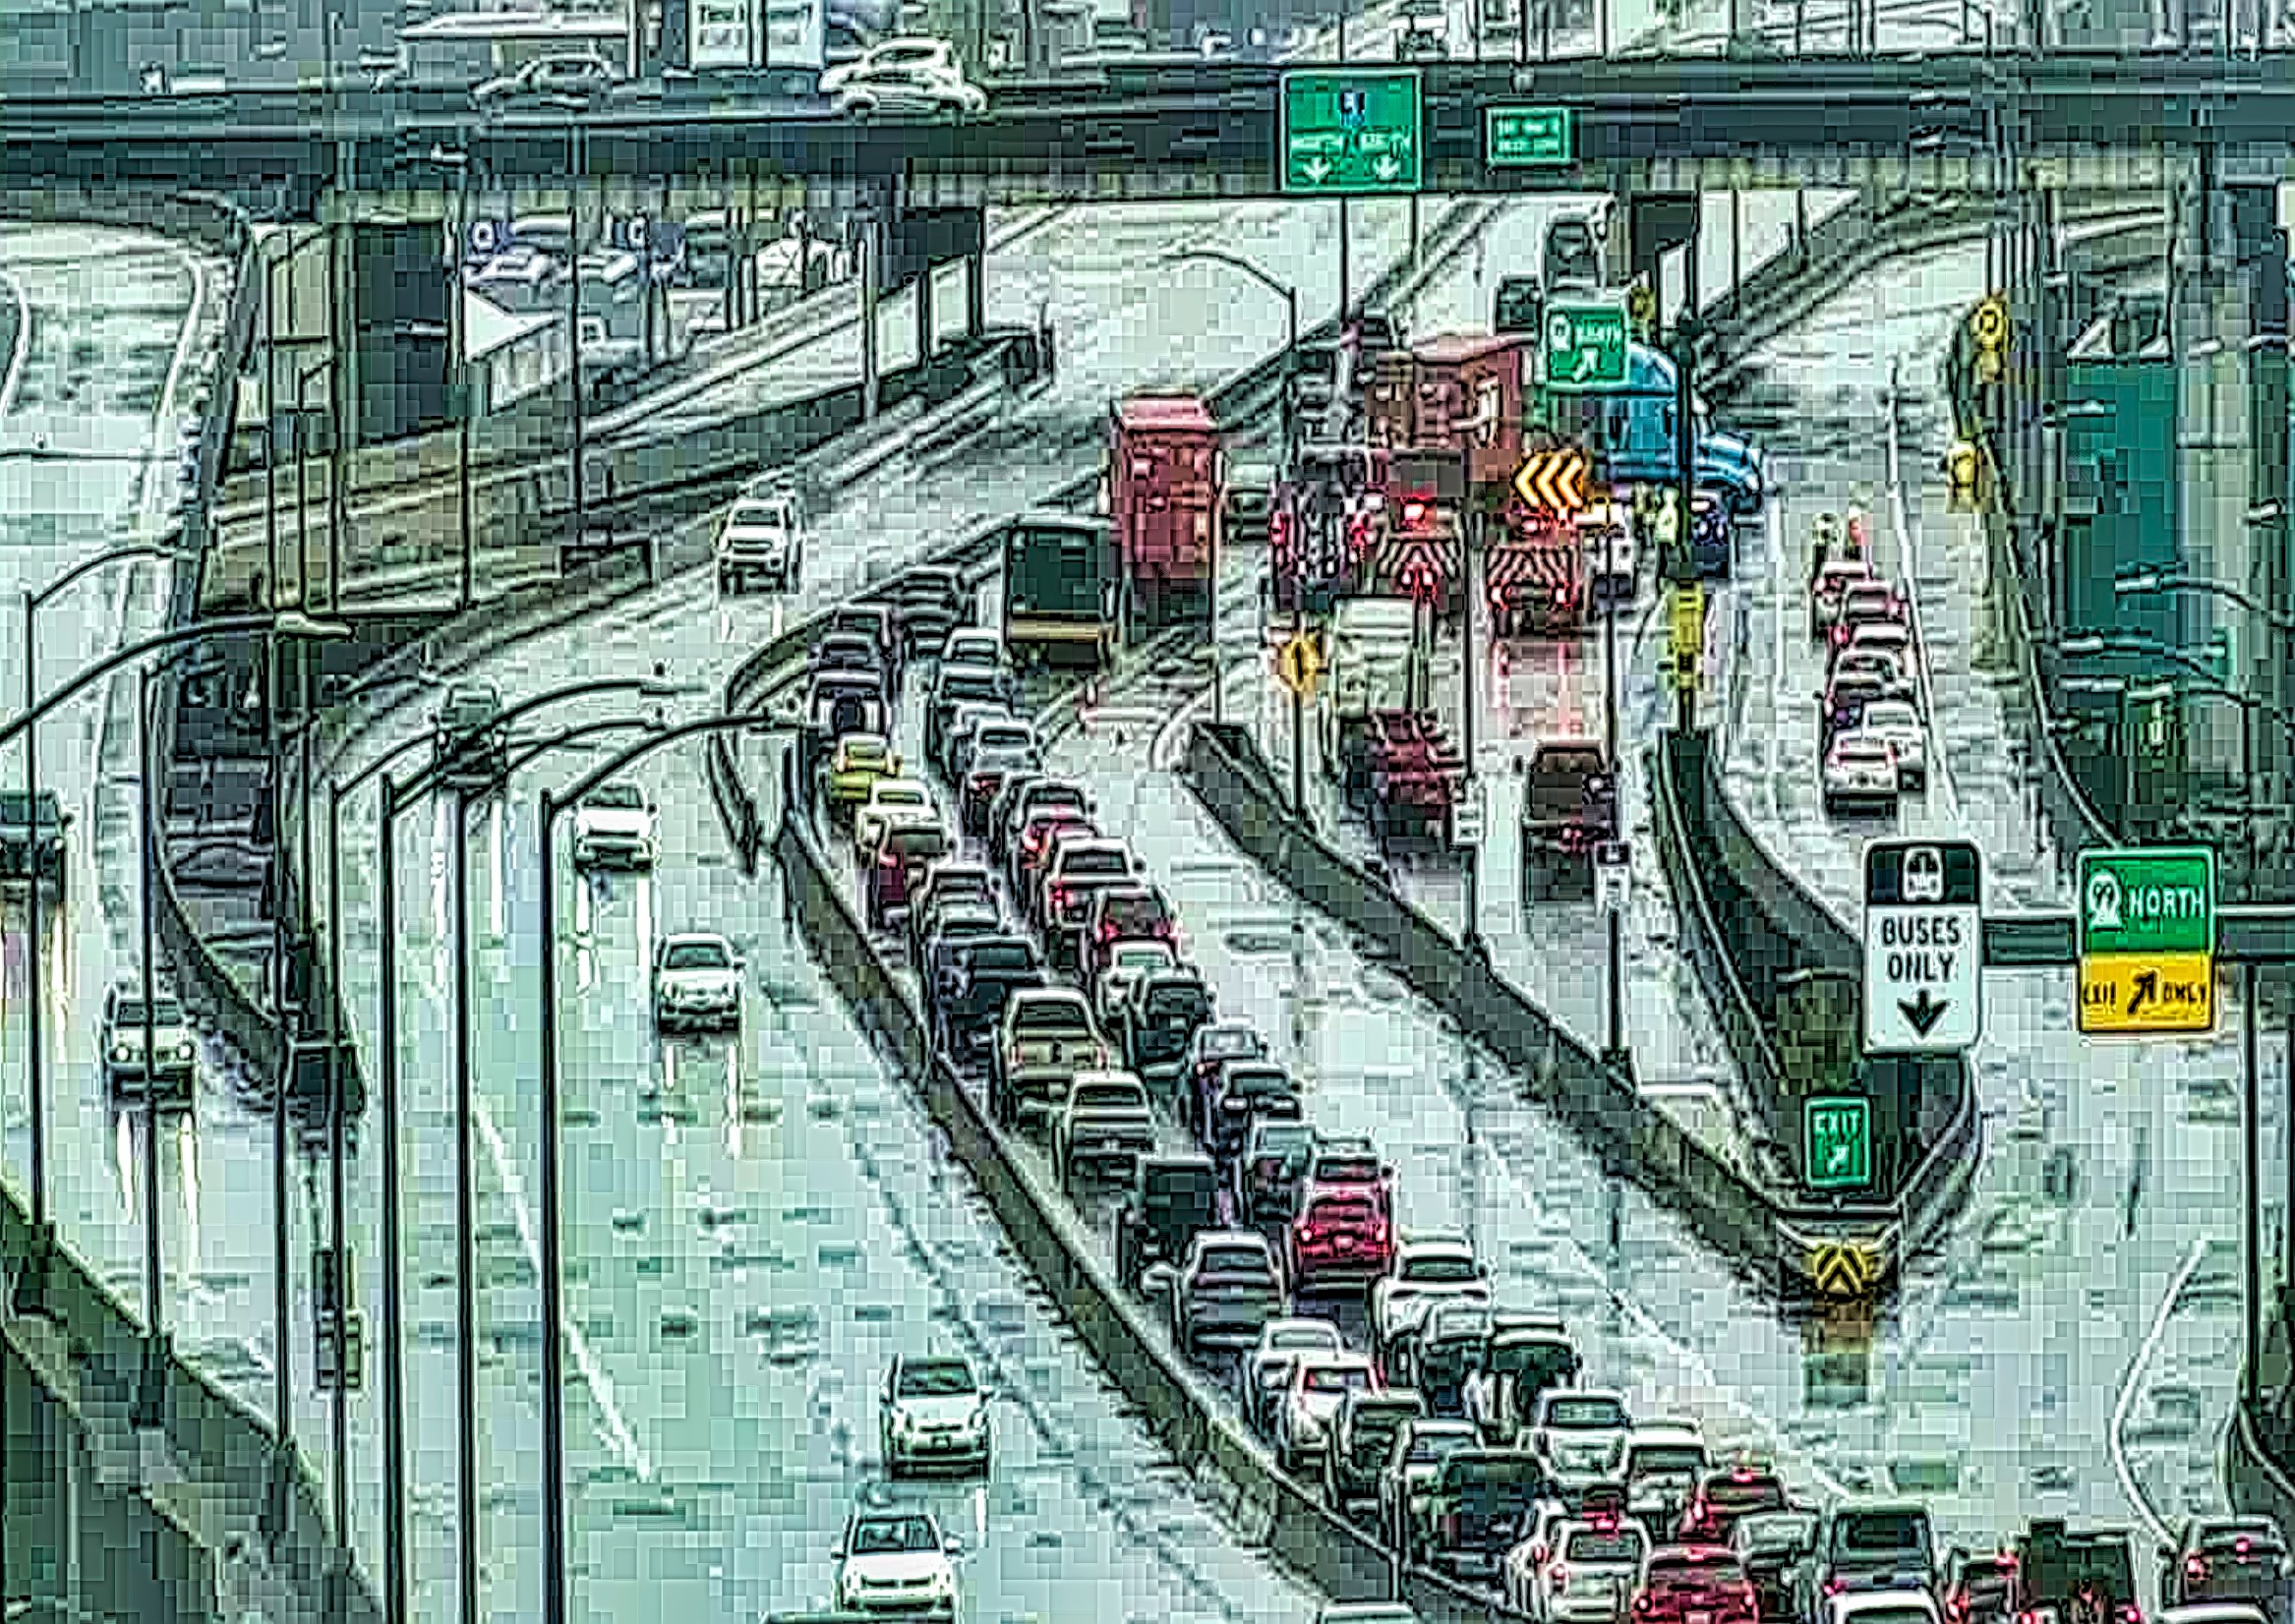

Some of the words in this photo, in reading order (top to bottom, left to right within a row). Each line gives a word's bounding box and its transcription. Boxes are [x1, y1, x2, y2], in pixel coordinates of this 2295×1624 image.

[2128, 885, 2205, 918] NORTH
[1882, 915, 1961, 947] BUSES
[1887, 951, 1956, 983] ONLY
[1812, 1110, 1861, 1133] EXIT
